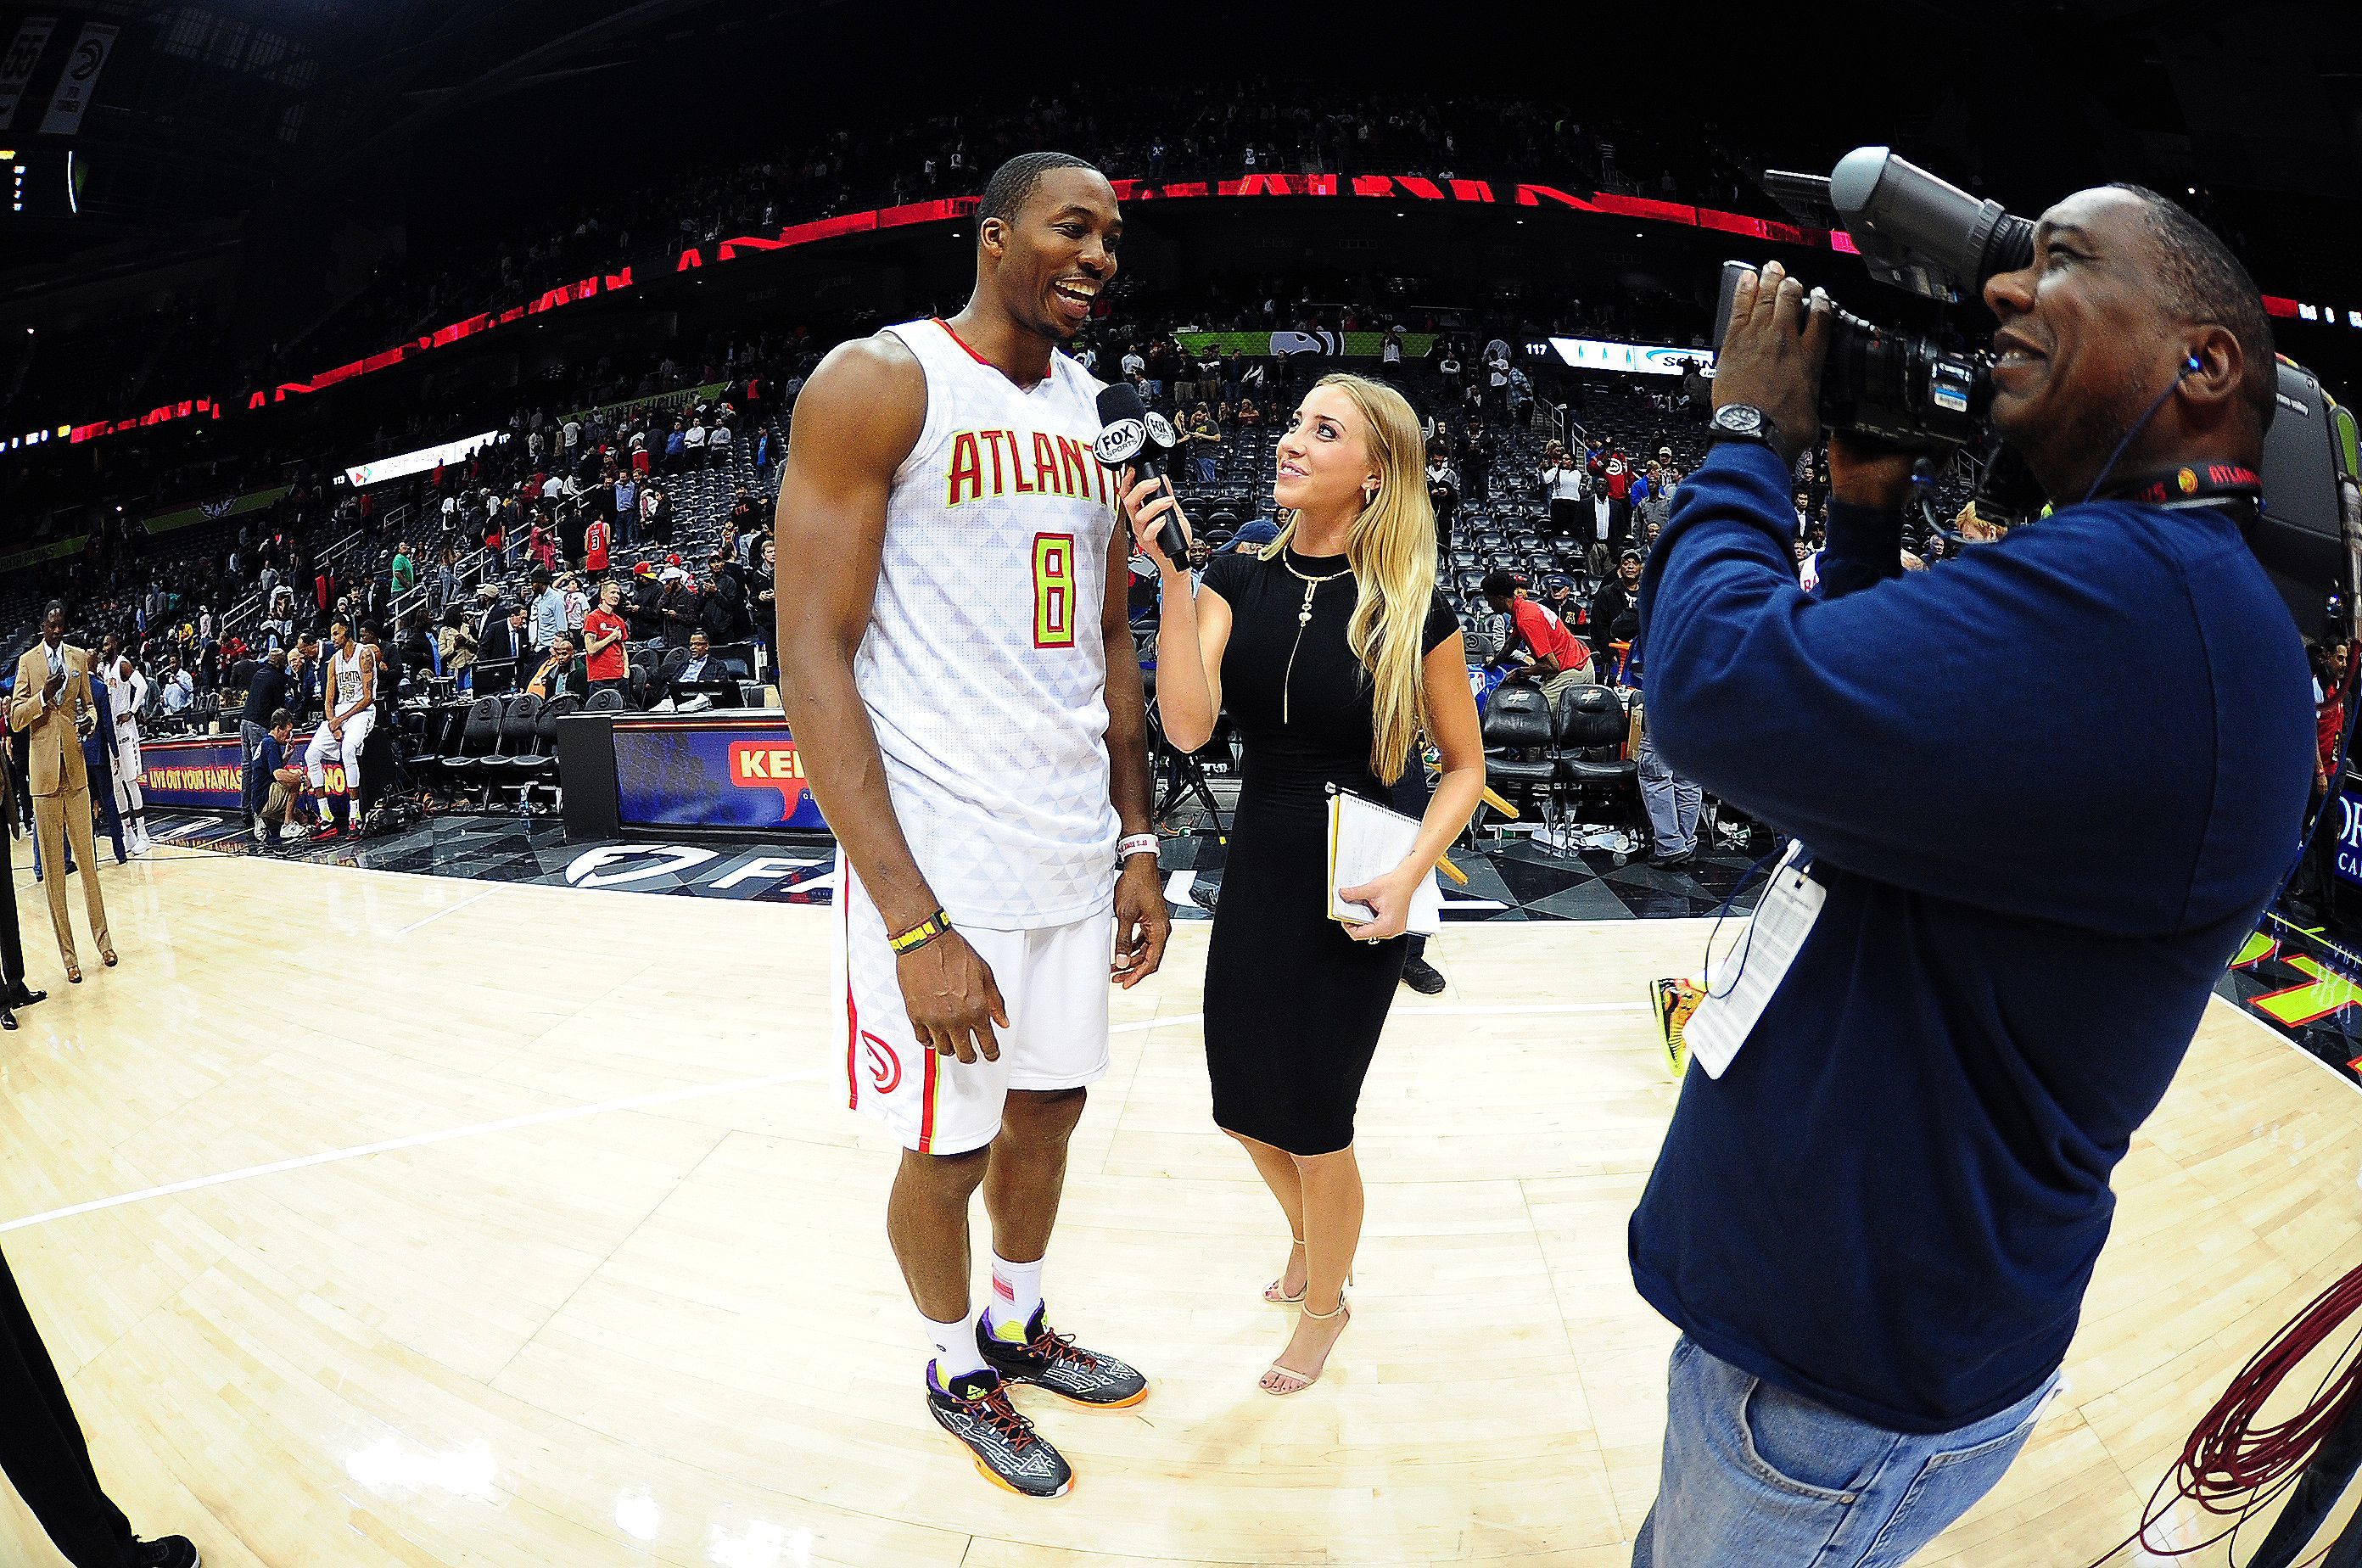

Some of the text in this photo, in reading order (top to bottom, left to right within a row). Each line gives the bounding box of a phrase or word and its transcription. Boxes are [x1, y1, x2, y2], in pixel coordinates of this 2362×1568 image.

[1525, 343, 1548, 356] 117
[1103, 424, 1134, 451] FOX
[1106, 438, 1138, 458] SPORTS
[1031, 531, 1077, 650] 8
[149, 768, 167, 789] LIVE
[166, 767, 182, 790] OUT
[181, 767, 204, 790] YOUR
[204, 765, 243, 792] FANTAS
